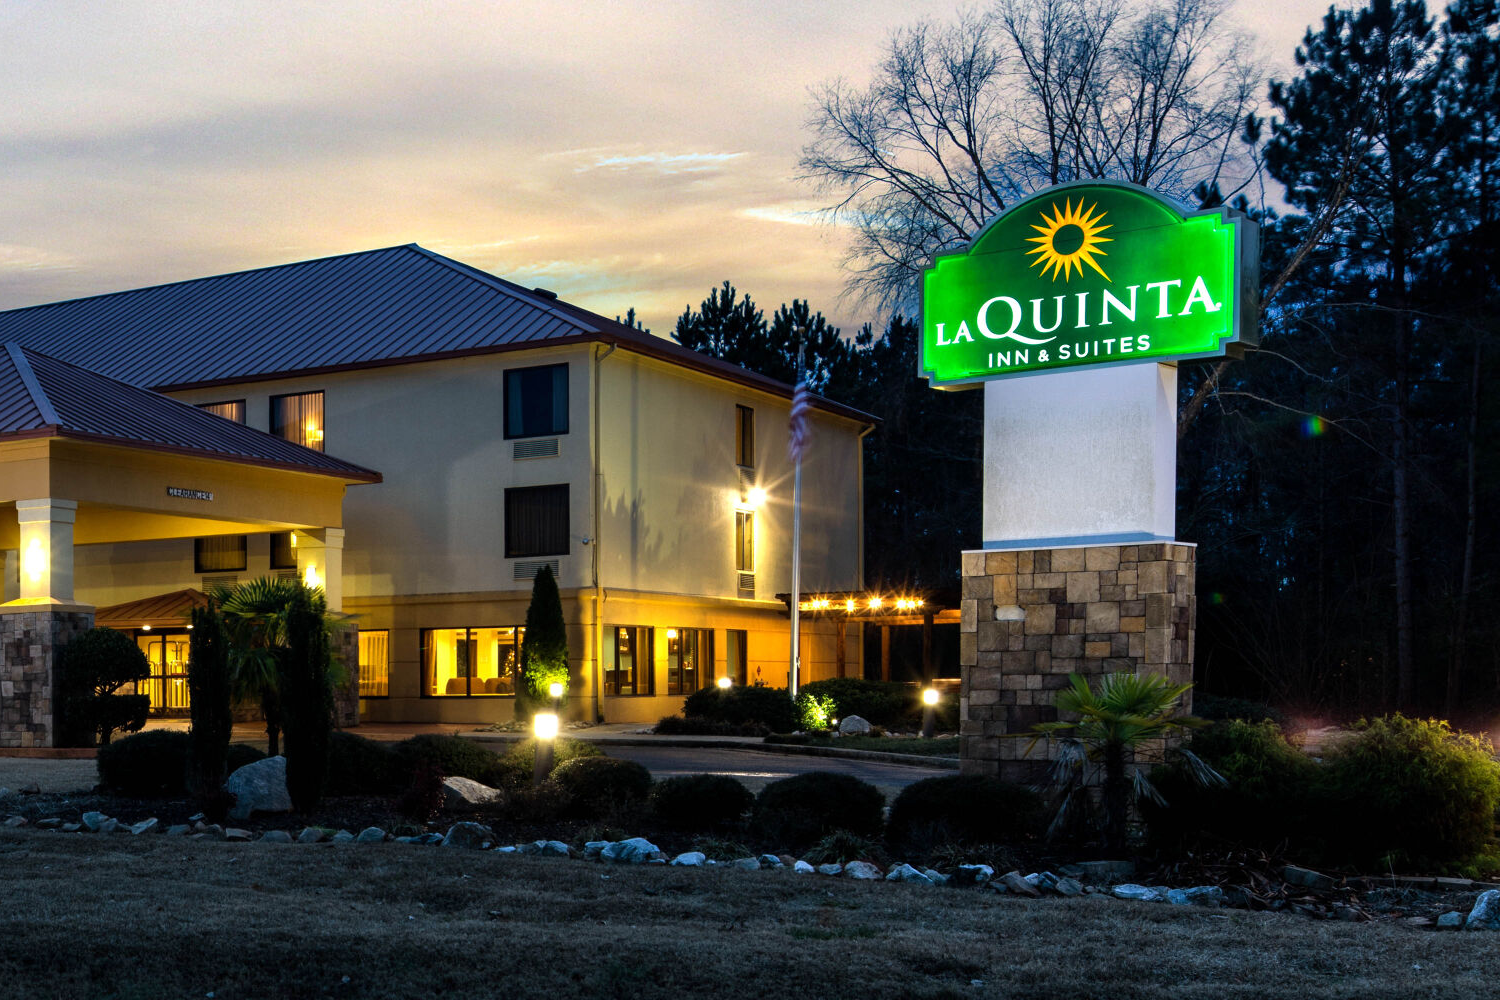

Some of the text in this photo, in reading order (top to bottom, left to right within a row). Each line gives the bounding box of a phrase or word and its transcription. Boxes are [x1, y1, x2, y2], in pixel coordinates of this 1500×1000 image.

[935, 275, 1222, 346] LA QUINTA
[988, 334, 1151, 368] INN & SUITES
